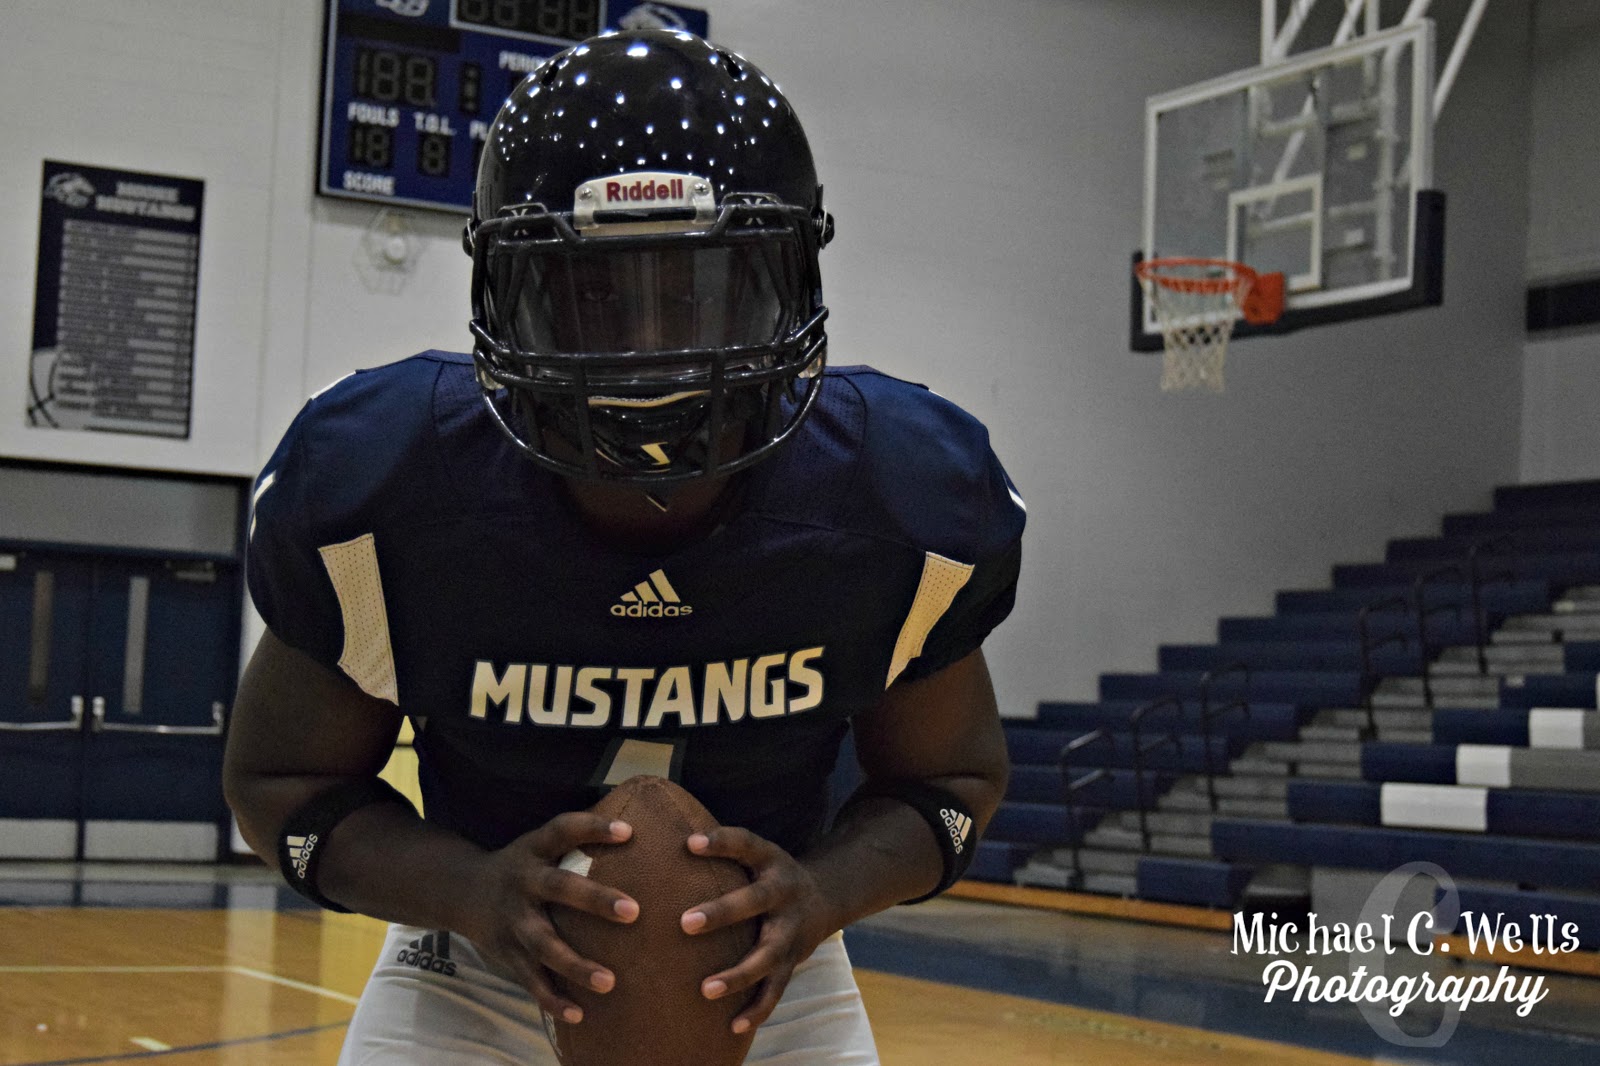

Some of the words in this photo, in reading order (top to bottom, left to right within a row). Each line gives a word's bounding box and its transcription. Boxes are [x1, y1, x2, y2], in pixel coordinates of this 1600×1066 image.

[347, 101, 400, 128] FOULS
[342, 169, 396, 197] SCORE
[606, 178, 684, 202] Riddell
[610, 600, 693, 618] adidas
[468, 645, 825, 729] MUSTANGS
[940, 808, 963, 854] adidas
[297, 833, 318, 879] adidas
[397, 949, 456, 976] adidas
